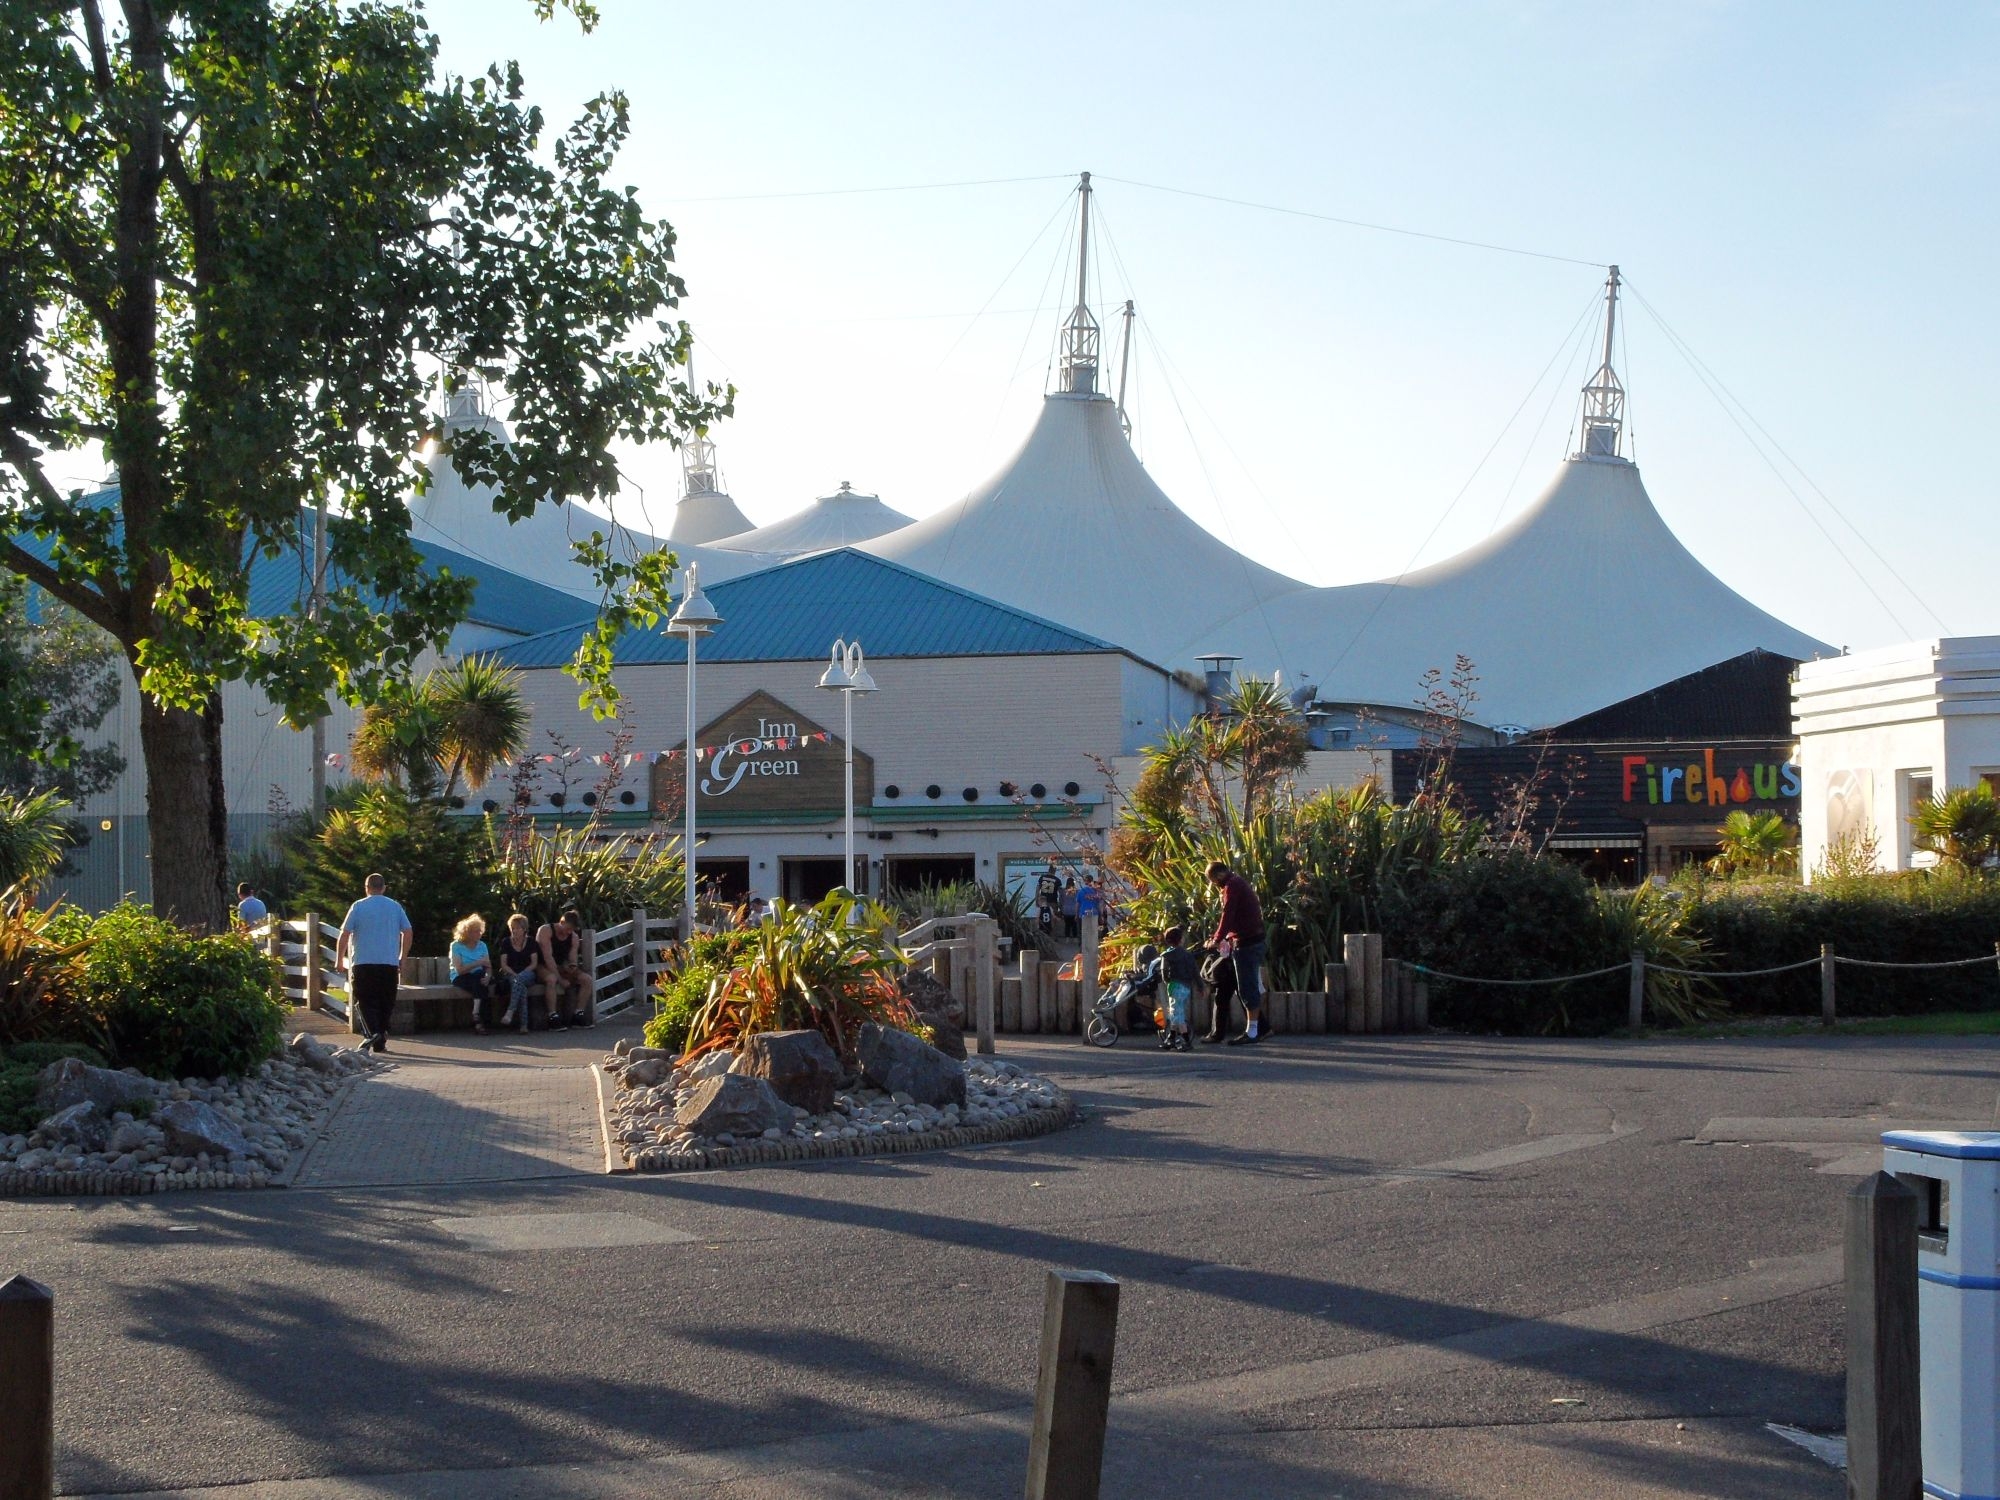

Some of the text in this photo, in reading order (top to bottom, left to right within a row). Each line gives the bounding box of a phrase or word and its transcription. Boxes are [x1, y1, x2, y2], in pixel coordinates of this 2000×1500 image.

[758, 718, 797, 738] Inn
[700, 732, 800, 796] Green
[1042, 912, 1050, 923] 8
